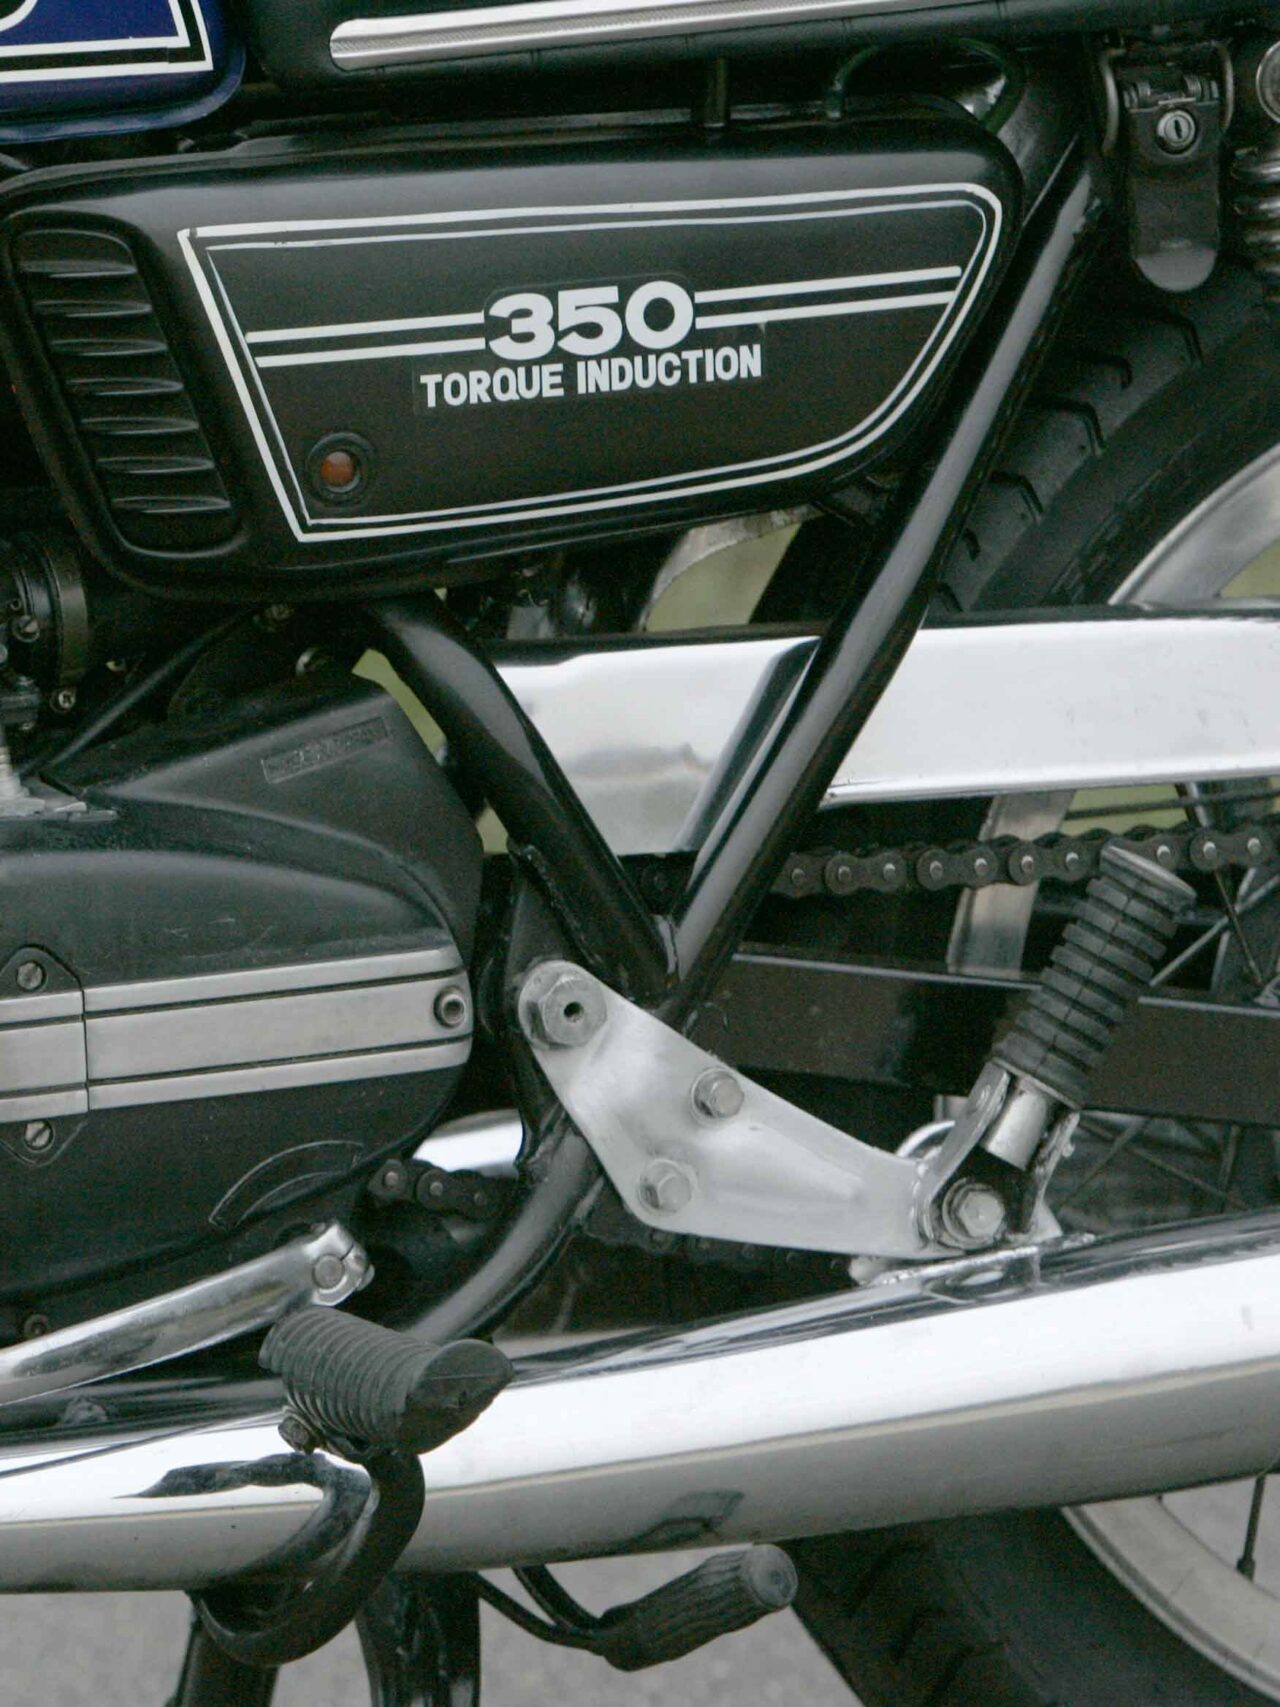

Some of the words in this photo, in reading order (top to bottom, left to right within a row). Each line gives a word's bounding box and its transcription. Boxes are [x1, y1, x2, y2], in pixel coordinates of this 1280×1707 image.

[488, 280, 694, 361] 350
[420, 363, 565, 408] TORQUE
[576, 344, 762, 395] INDUCTION
